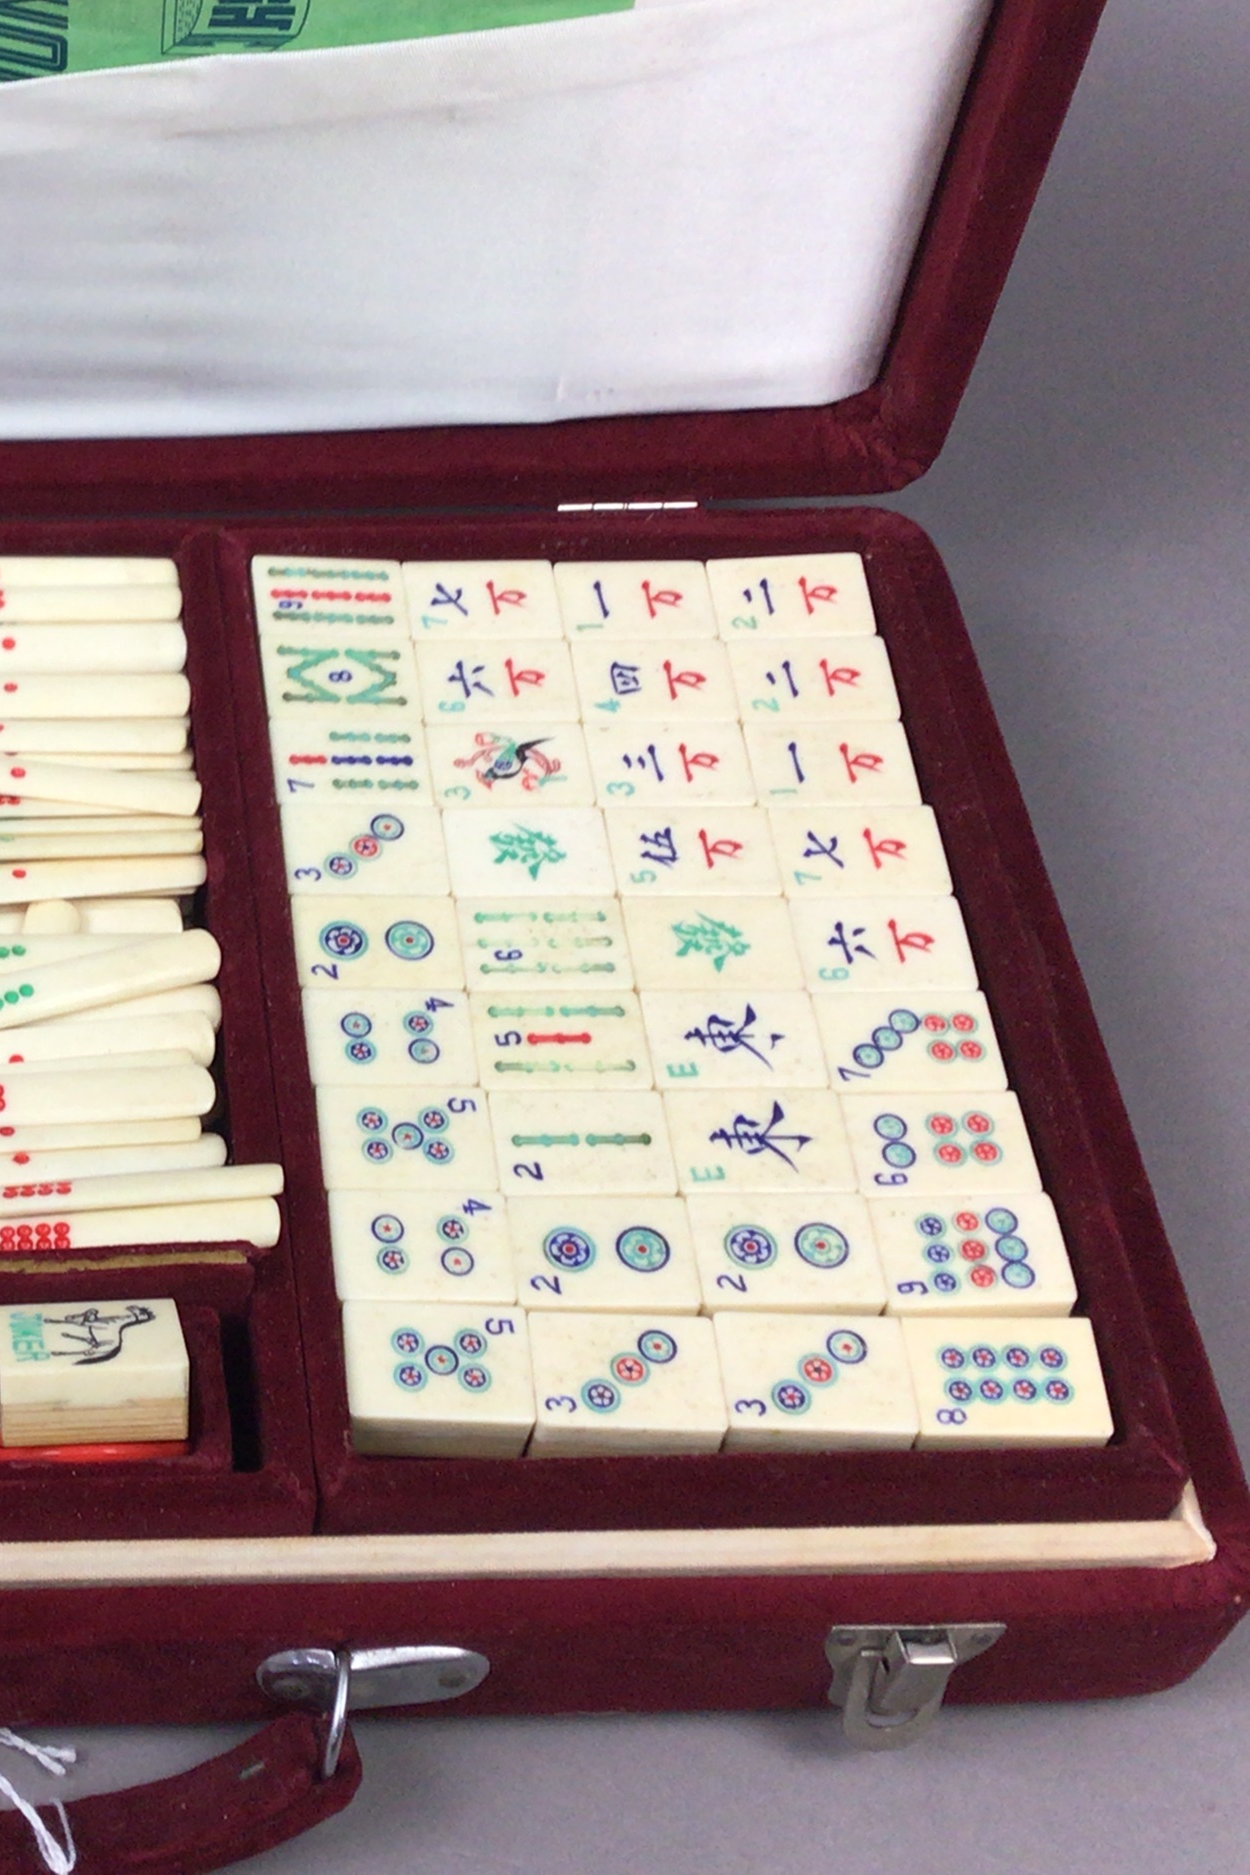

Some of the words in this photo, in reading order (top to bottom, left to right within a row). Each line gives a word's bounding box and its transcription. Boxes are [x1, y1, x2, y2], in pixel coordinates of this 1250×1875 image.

[421, 615, 447, 629] 7
[576, 623, 604, 632] 1
[731, 616, 757, 629] 2
[328, 670, 352, 682] 8
[595, 698, 620, 713] 4
[752, 698, 780, 712] 2
[287, 778, 314, 793] 7
[444, 786, 471, 800] 3
[606, 782, 635, 796] 3
[294, 868, 322, 881] 3
[630, 870, 657, 883] 5
[794, 871, 821, 885] 7
[494, 950, 523, 961] 6
[311, 964, 338, 980] 2
[818, 967, 849, 981] 6
[425, 997, 454, 1012] 4
[494, 1031, 522, 1046] 5
[666, 1062, 699, 1078] E
[838, 1064, 873, 1081] 7
[447, 1098, 476, 1113] 5
[513, 1162, 543, 1180] 2
[690, 1166, 726, 1182] E
[874, 1173, 908, 1185] 6
[462, 1199, 492, 1216] 4
[530, 1276, 562, 1294] 2
[717, 1275, 747, 1292] 2
[897, 1281, 929, 1295] 9
[485, 1318, 514, 1335] 5
[545, 1396, 577, 1413] 3
[735, 1399, 767, 1416] 3
[936, 1407, 967, 1425] 8
